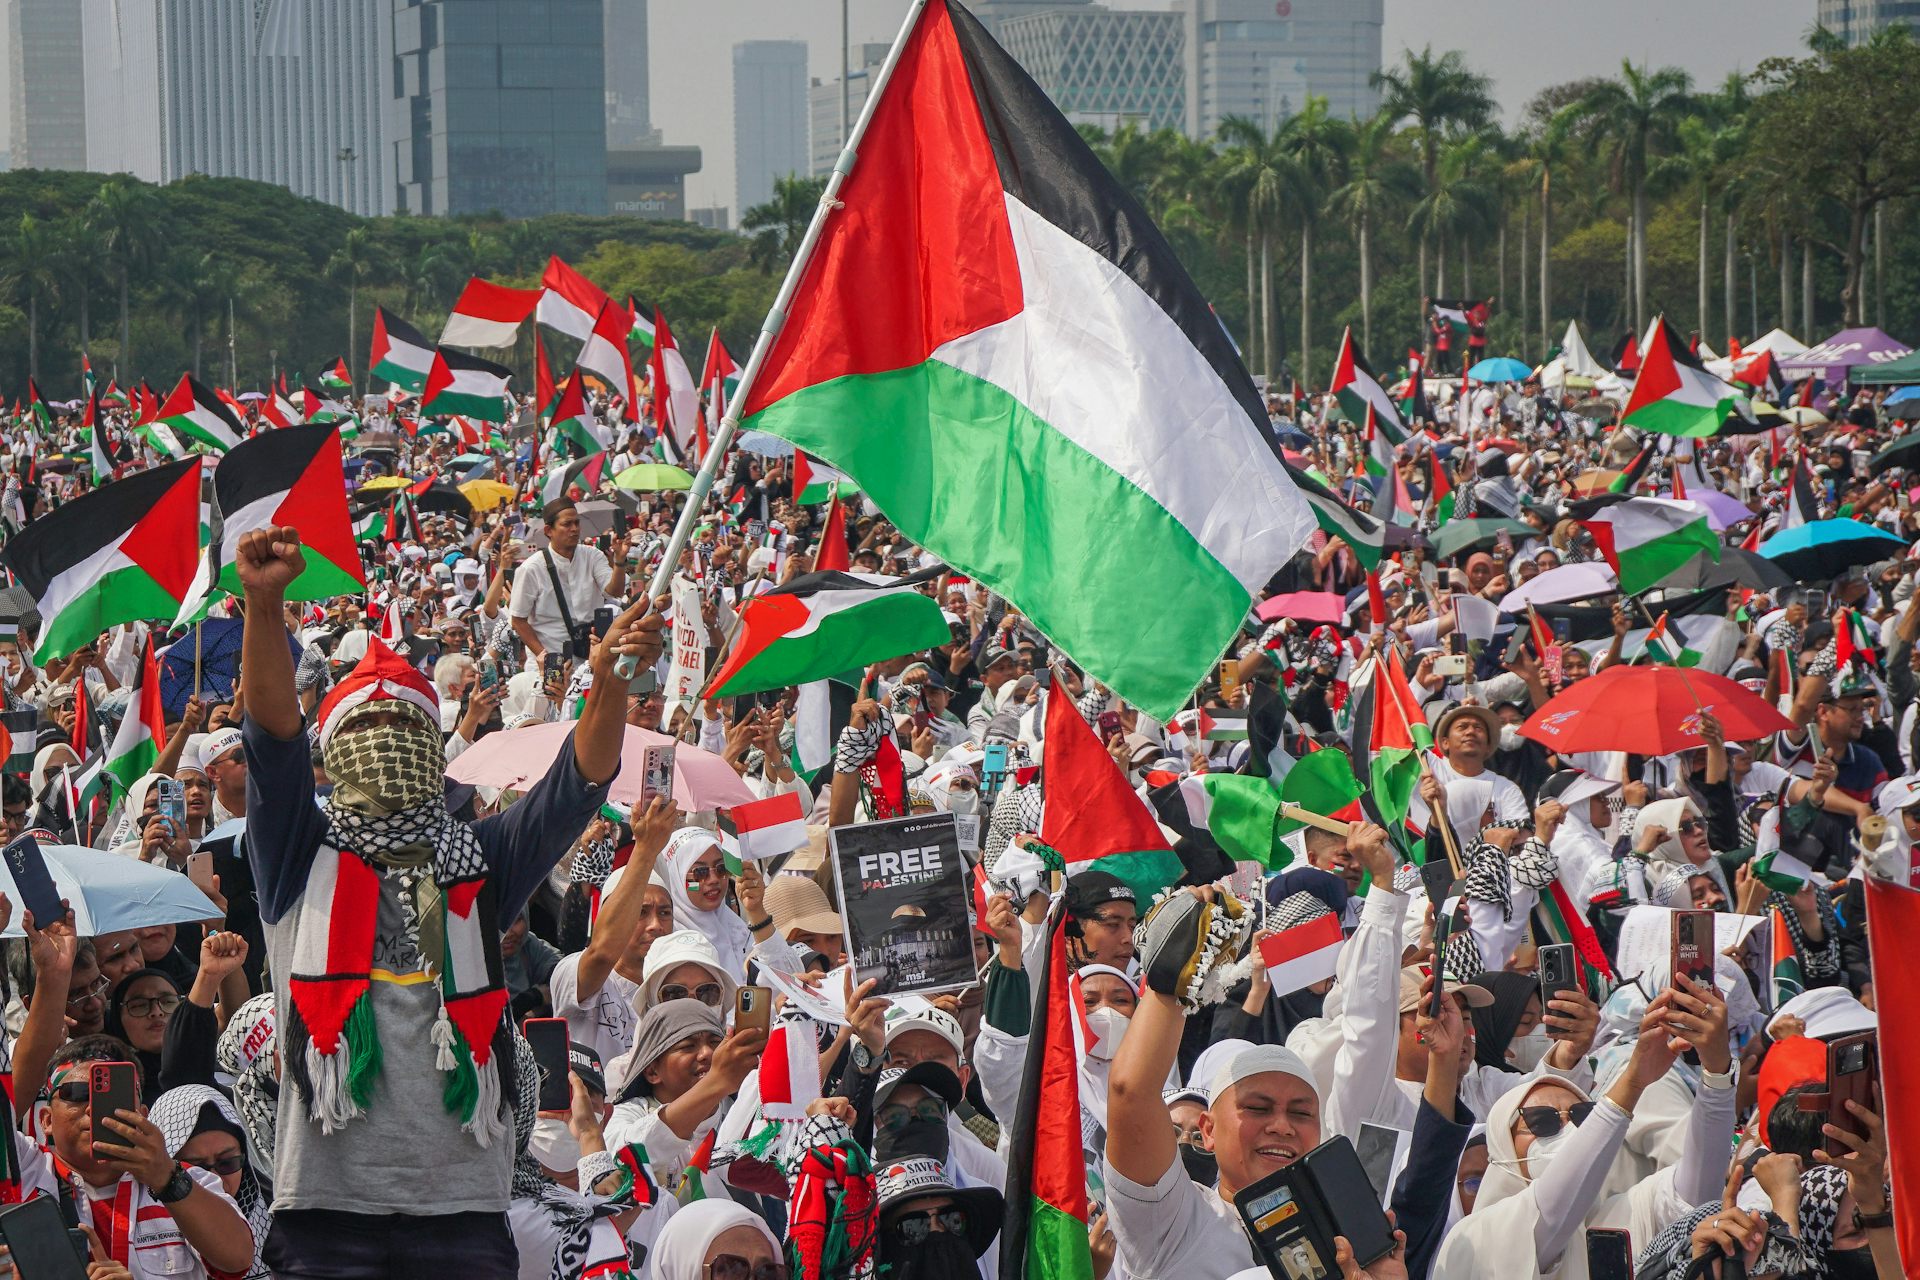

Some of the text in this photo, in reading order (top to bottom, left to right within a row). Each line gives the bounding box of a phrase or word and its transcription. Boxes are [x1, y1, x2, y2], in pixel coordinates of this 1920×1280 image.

[615, 198, 665, 211] mandiri
[220, 734, 235, 747] SAVE
[859, 845, 942, 879] FREE
[862, 869, 944, 891] PALESTINE
[1680, 944, 1698, 952] SNOW
[906, 970, 925, 981] msf
[243, 1017, 273, 1061] FREE
[907, 1160, 934, 1174] SAVE
